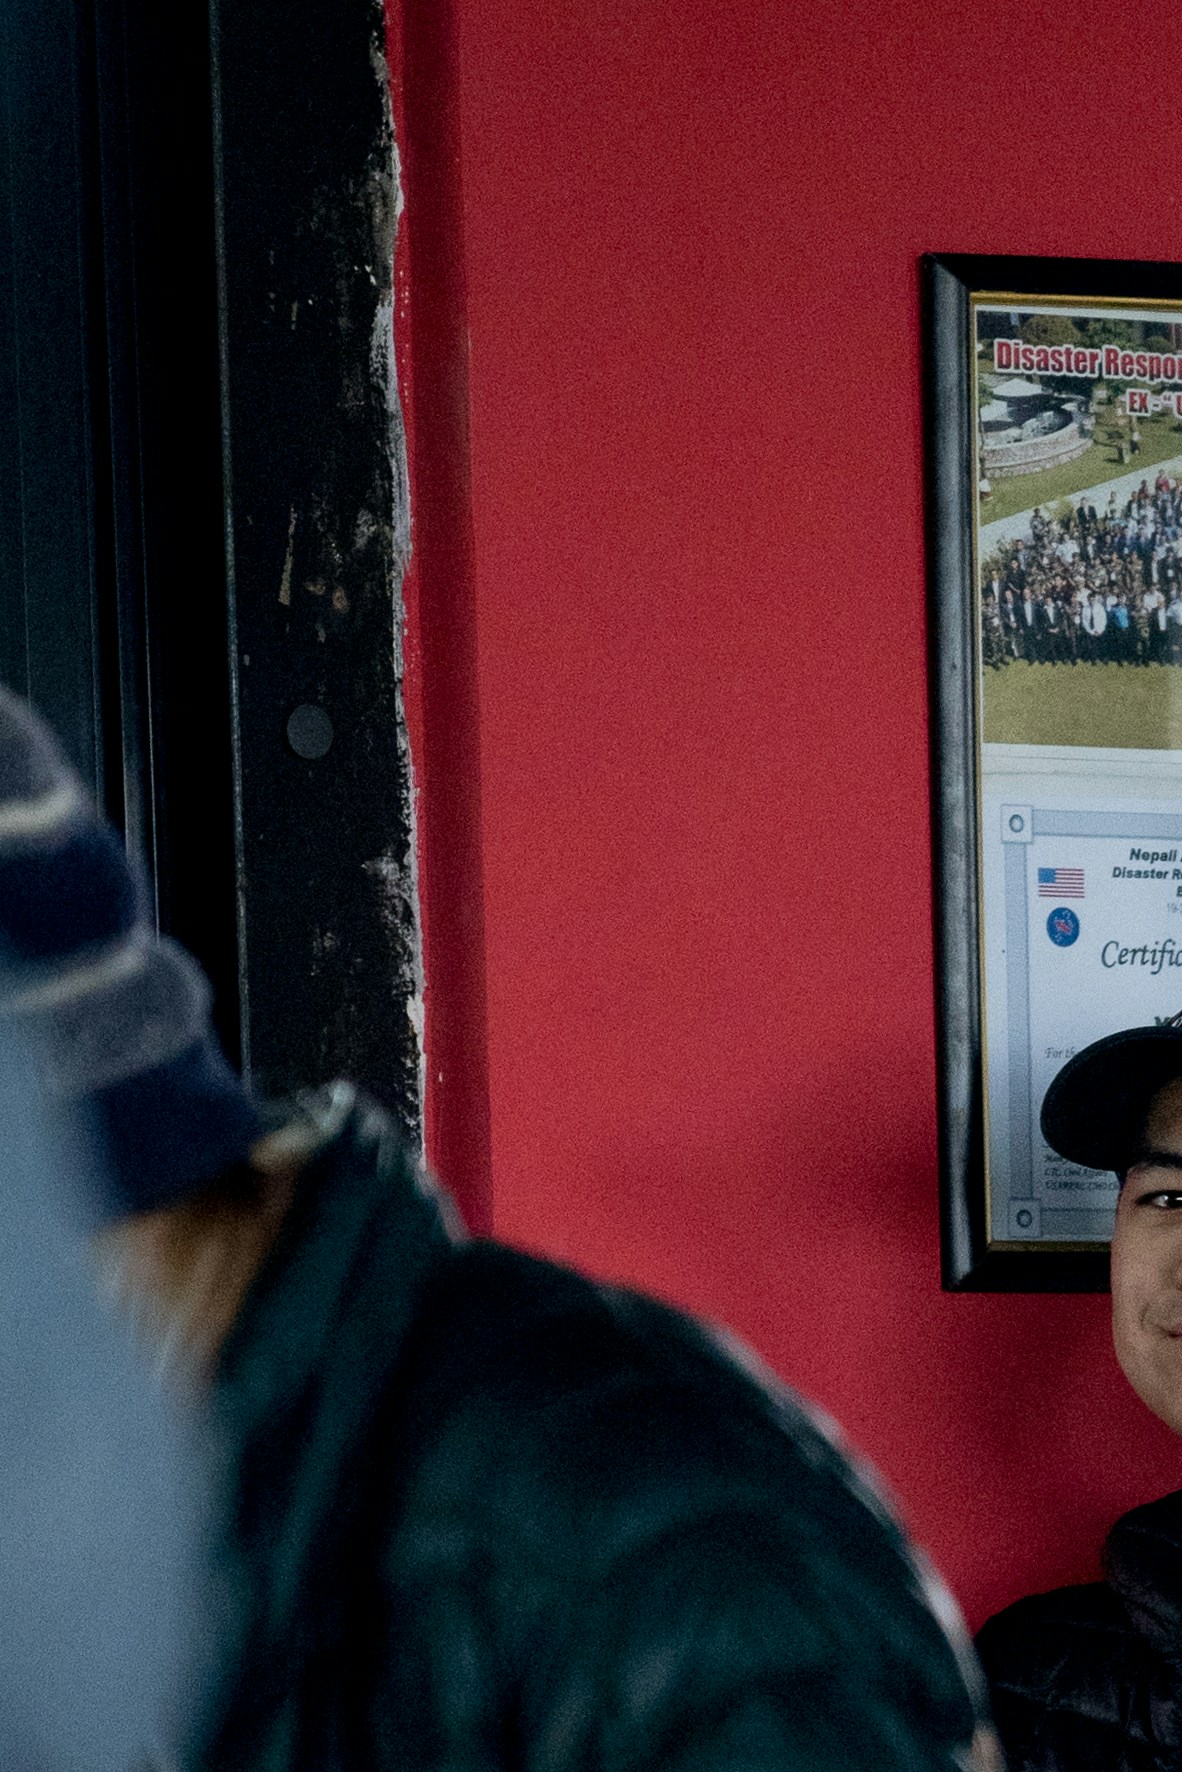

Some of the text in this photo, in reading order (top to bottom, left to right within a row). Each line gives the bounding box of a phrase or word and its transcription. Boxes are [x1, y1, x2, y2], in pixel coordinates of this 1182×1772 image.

[995, 341, 1100, 375] Disaster
[1128, 391, 1149, 413] EX
[1129, 848, 1177, 864] Nepali
[1112, 866, 1169, 880] Disaster
